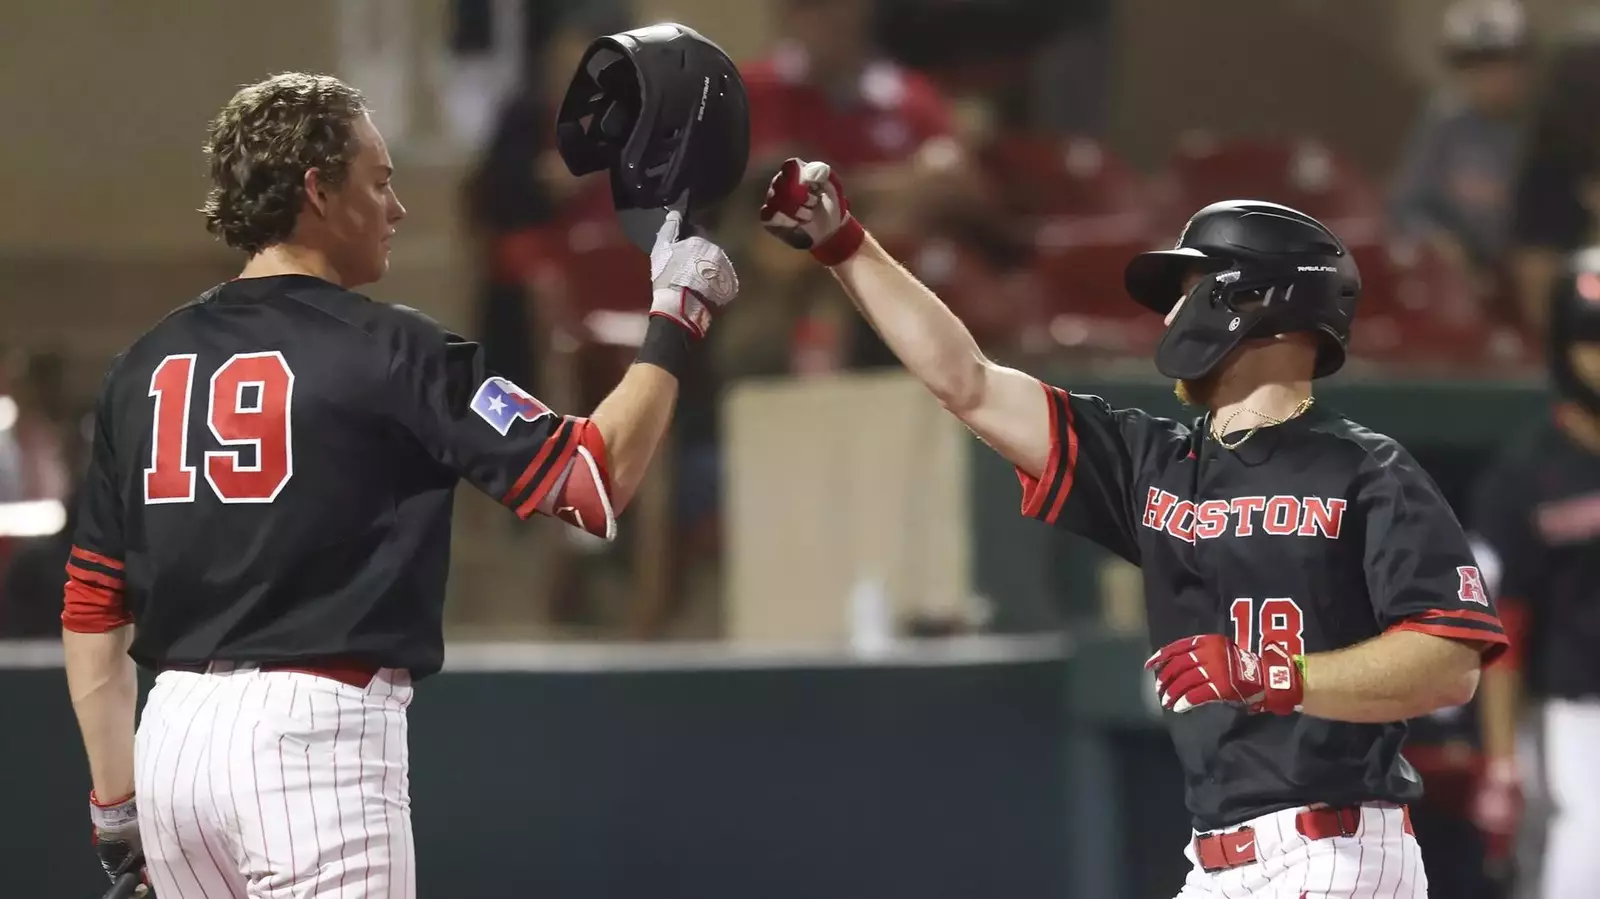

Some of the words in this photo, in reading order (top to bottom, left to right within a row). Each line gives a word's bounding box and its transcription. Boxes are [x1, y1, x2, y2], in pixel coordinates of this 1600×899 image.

[143, 350, 296, 505] 19
[1142, 486, 1347, 546] HOSTON
[1230, 598, 1304, 658] 18
